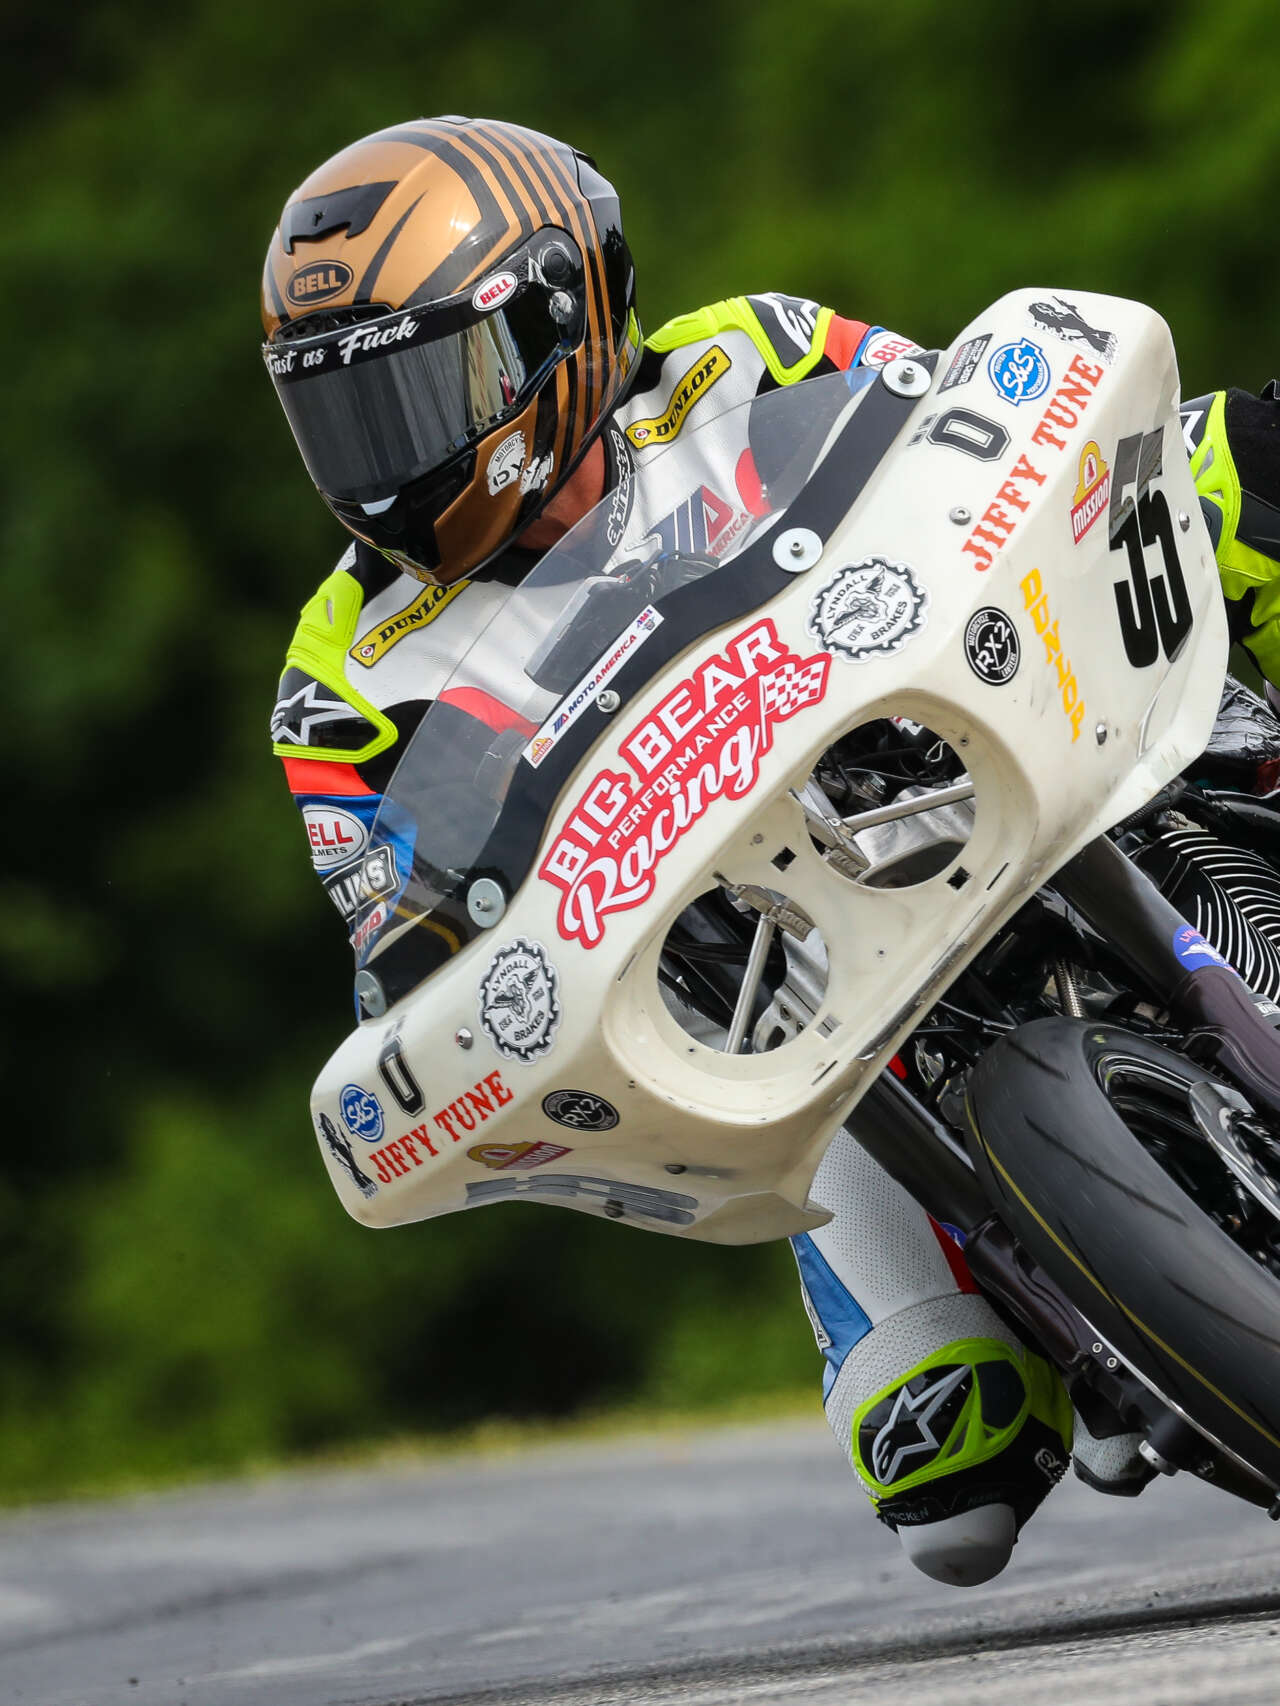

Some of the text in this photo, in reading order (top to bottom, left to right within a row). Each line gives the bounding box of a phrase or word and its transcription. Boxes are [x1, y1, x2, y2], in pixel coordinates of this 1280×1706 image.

[294, 270, 342, 297] BELL
[480, 279, 513, 305] BELL
[303, 347, 327, 368] as
[338, 316, 421, 365] Fuck
[872, 340, 916, 363] BEL
[656, 356, 718, 436] DUNLOP
[1002, 348, 1035, 396] S&S
[961, 454, 1047, 571] JIFFY
[1031, 354, 1104, 451] TUNE
[1073, 477, 1110, 537] MISSION
[1109, 425, 1193, 668] 55
[378, 585, 450, 644] DUNLO
[827, 575, 868, 620] LYNDALL
[870, 601, 908, 640] BRAKES
[975, 621, 1011, 674] RX2
[1020, 568, 1085, 745] DUNLOP
[568, 634, 637, 714] MOTOAMERICA
[546, 626, 783, 885] BIG BEAR
[607, 692, 752, 850] PERFORMANCE
[308, 821, 354, 847] ELL
[312, 847, 347, 857] LMETS
[563, 724, 761, 942] Racing
[492, 960, 529, 992] LYNDALL
[514, 1010, 545, 1041] BRAKES
[347, 1096, 375, 1129] S&S
[368, 1069, 514, 1184] JIFFY TUNE
[561, 1098, 602, 1126] RX2
